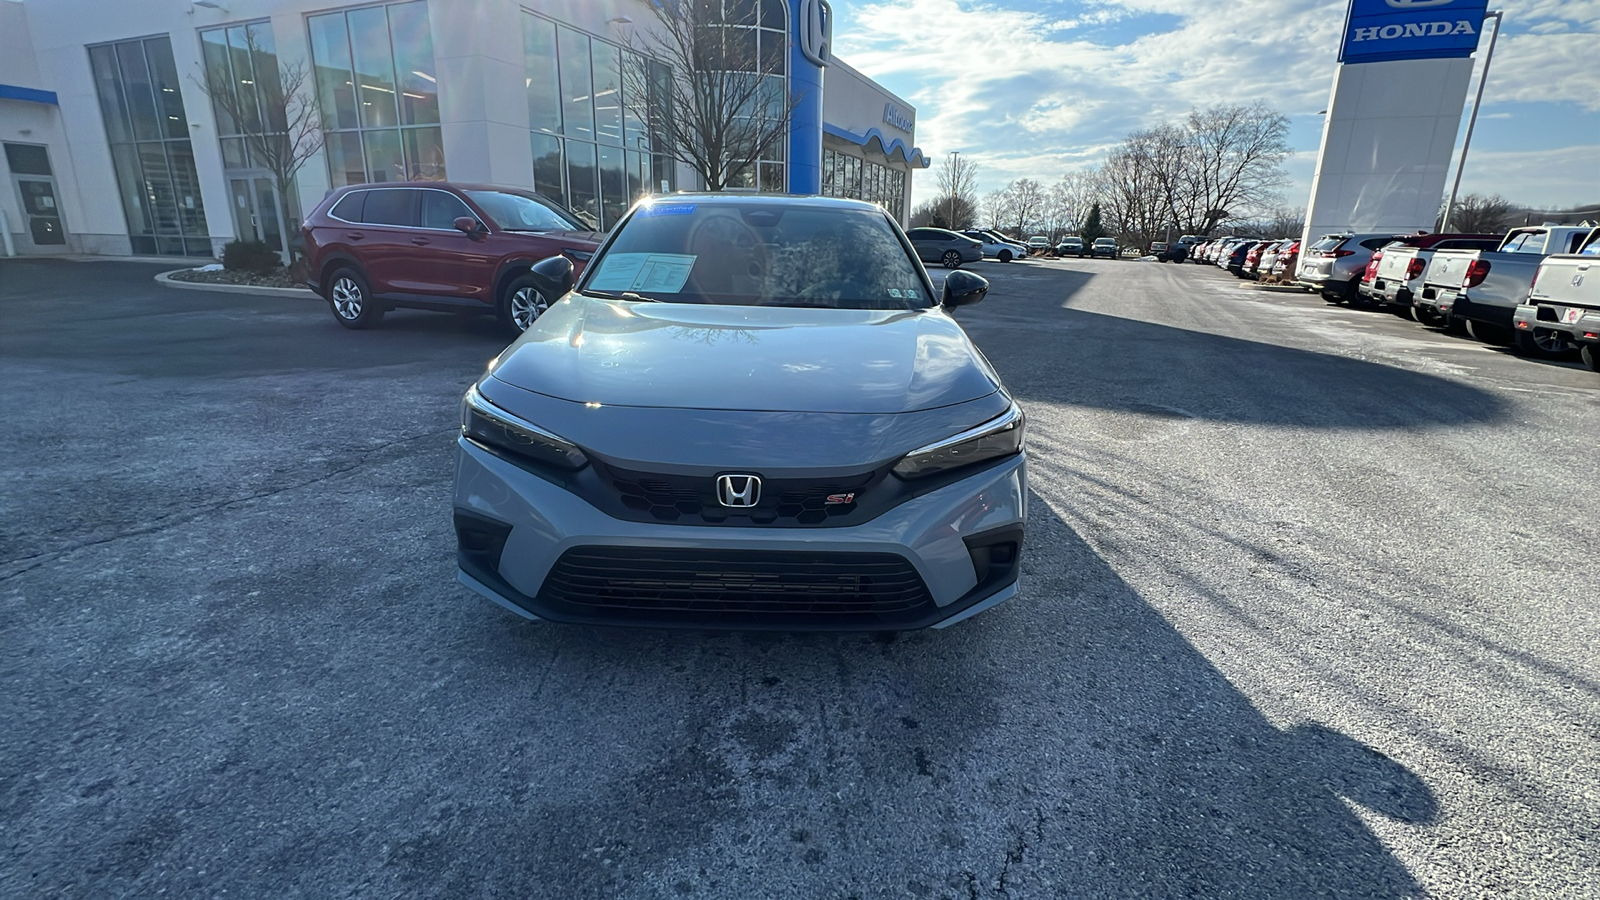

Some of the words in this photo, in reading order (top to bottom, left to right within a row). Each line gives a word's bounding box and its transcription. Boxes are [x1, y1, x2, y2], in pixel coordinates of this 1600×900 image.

[1352, 20, 1476, 42] HONDA
[884, 103, 914, 133] Altoona
[824, 492, 855, 505] Si
